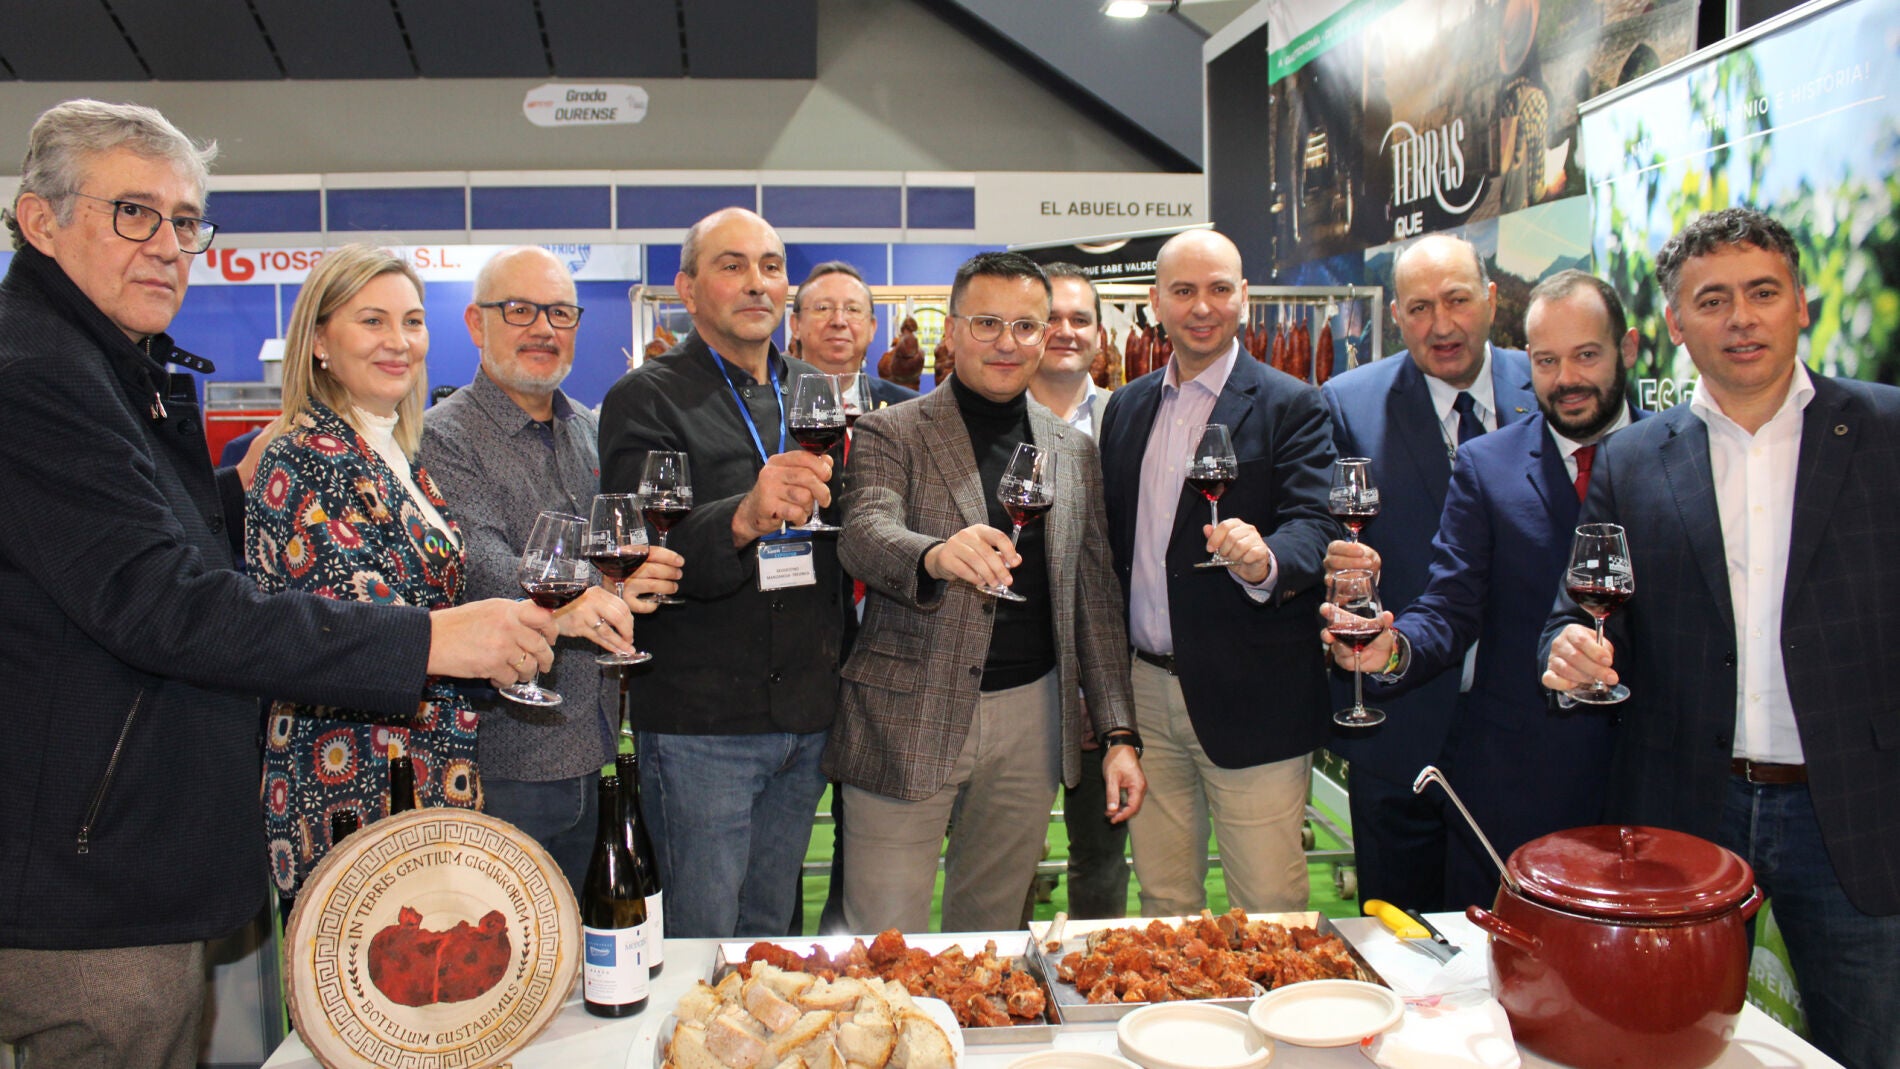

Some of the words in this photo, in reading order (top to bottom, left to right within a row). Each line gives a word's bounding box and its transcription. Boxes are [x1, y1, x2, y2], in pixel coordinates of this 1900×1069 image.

[566, 88, 607, 102] Grada
[555, 107, 618, 120] OURENSE
[1379, 118, 1485, 214] TERRAS
[1041, 202, 1062, 215] EL
[1068, 202, 1140, 216] ABUELO
[1146, 203, 1193, 216] FELIX
[1394, 211, 1423, 238] QUE
[414, 248, 462, 269] S.L.
[1101, 263, 1123, 274] SABE
[396, 850, 464, 877] GENTIUM
[355, 872, 397, 921] TERRIS
[465, 854, 531, 924] GIGURRORUM
[350, 920, 365, 940] IN
[361, 999, 431, 1046] BOTELLUM
[435, 983, 520, 1045] GUSTABIMUS
